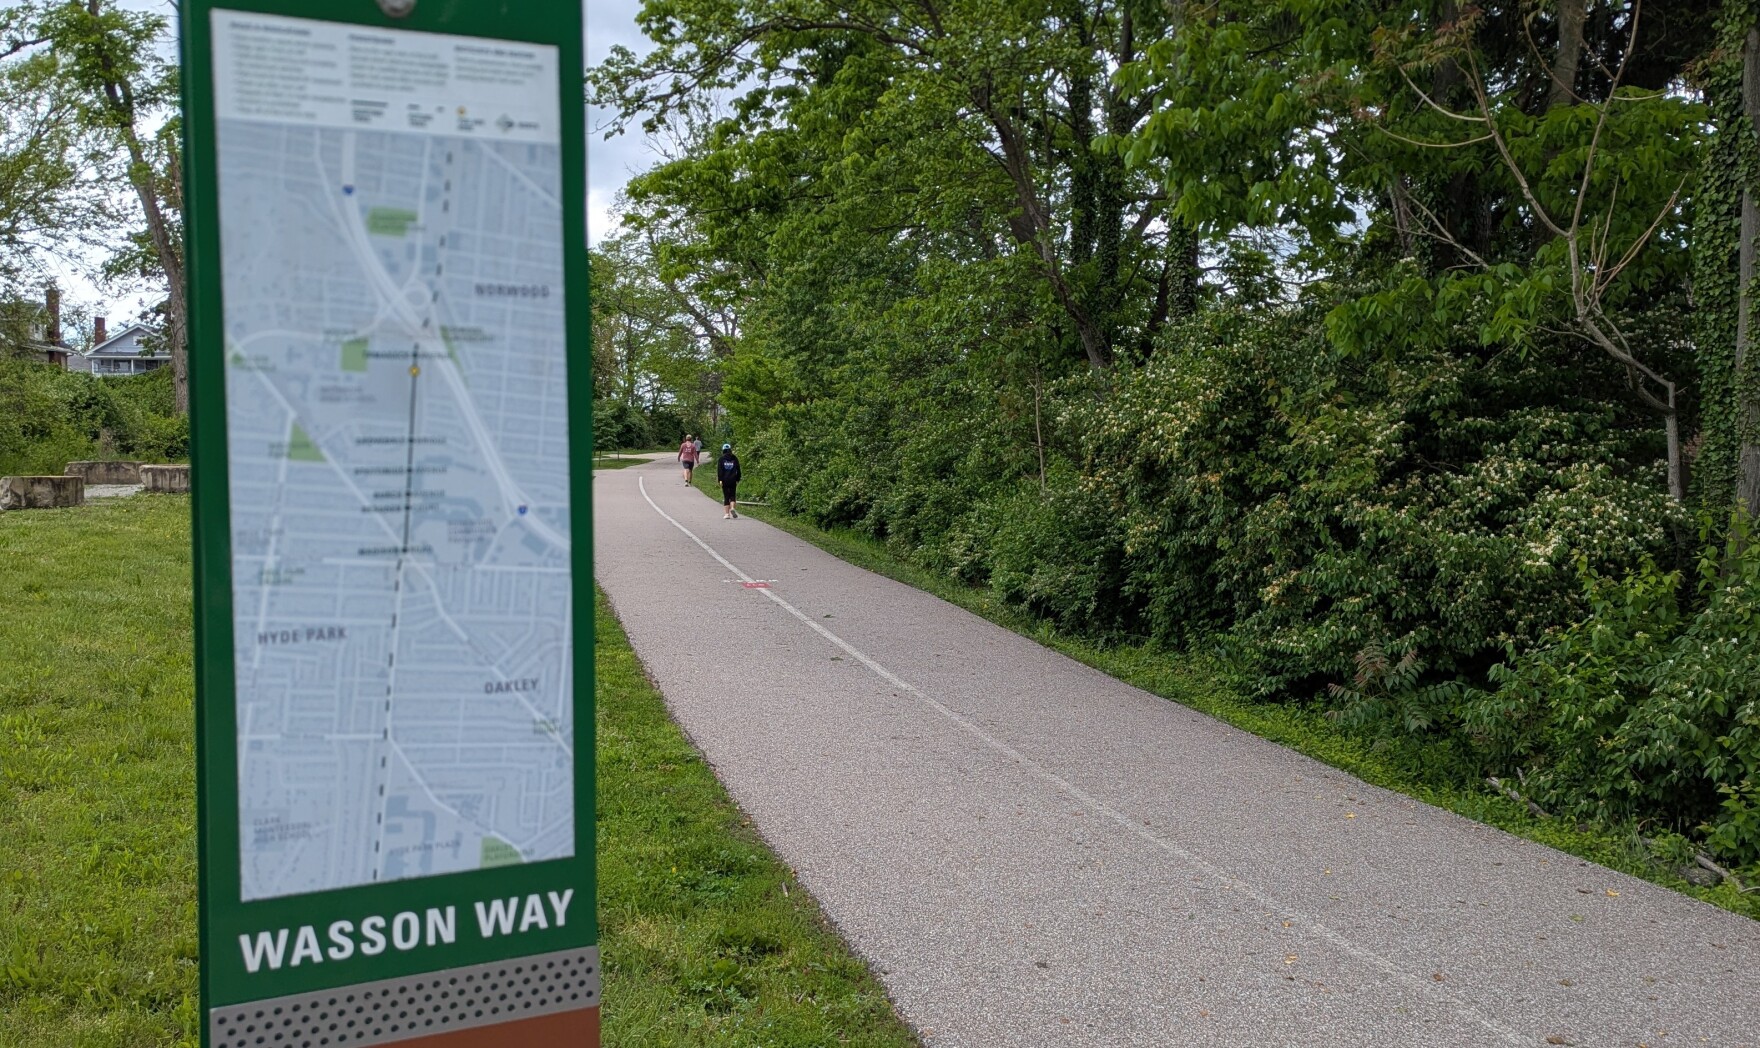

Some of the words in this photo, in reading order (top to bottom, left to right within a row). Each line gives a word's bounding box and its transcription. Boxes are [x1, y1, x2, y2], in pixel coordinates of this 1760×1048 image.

[475, 284, 549, 298] NORWOOD
[258, 629, 299, 644] HYDE
[306, 626, 347, 641] PARK
[484, 678, 539, 694] OAKLEY
[238, 906, 456, 973] WASSON
[474, 888, 575, 939] WAY
